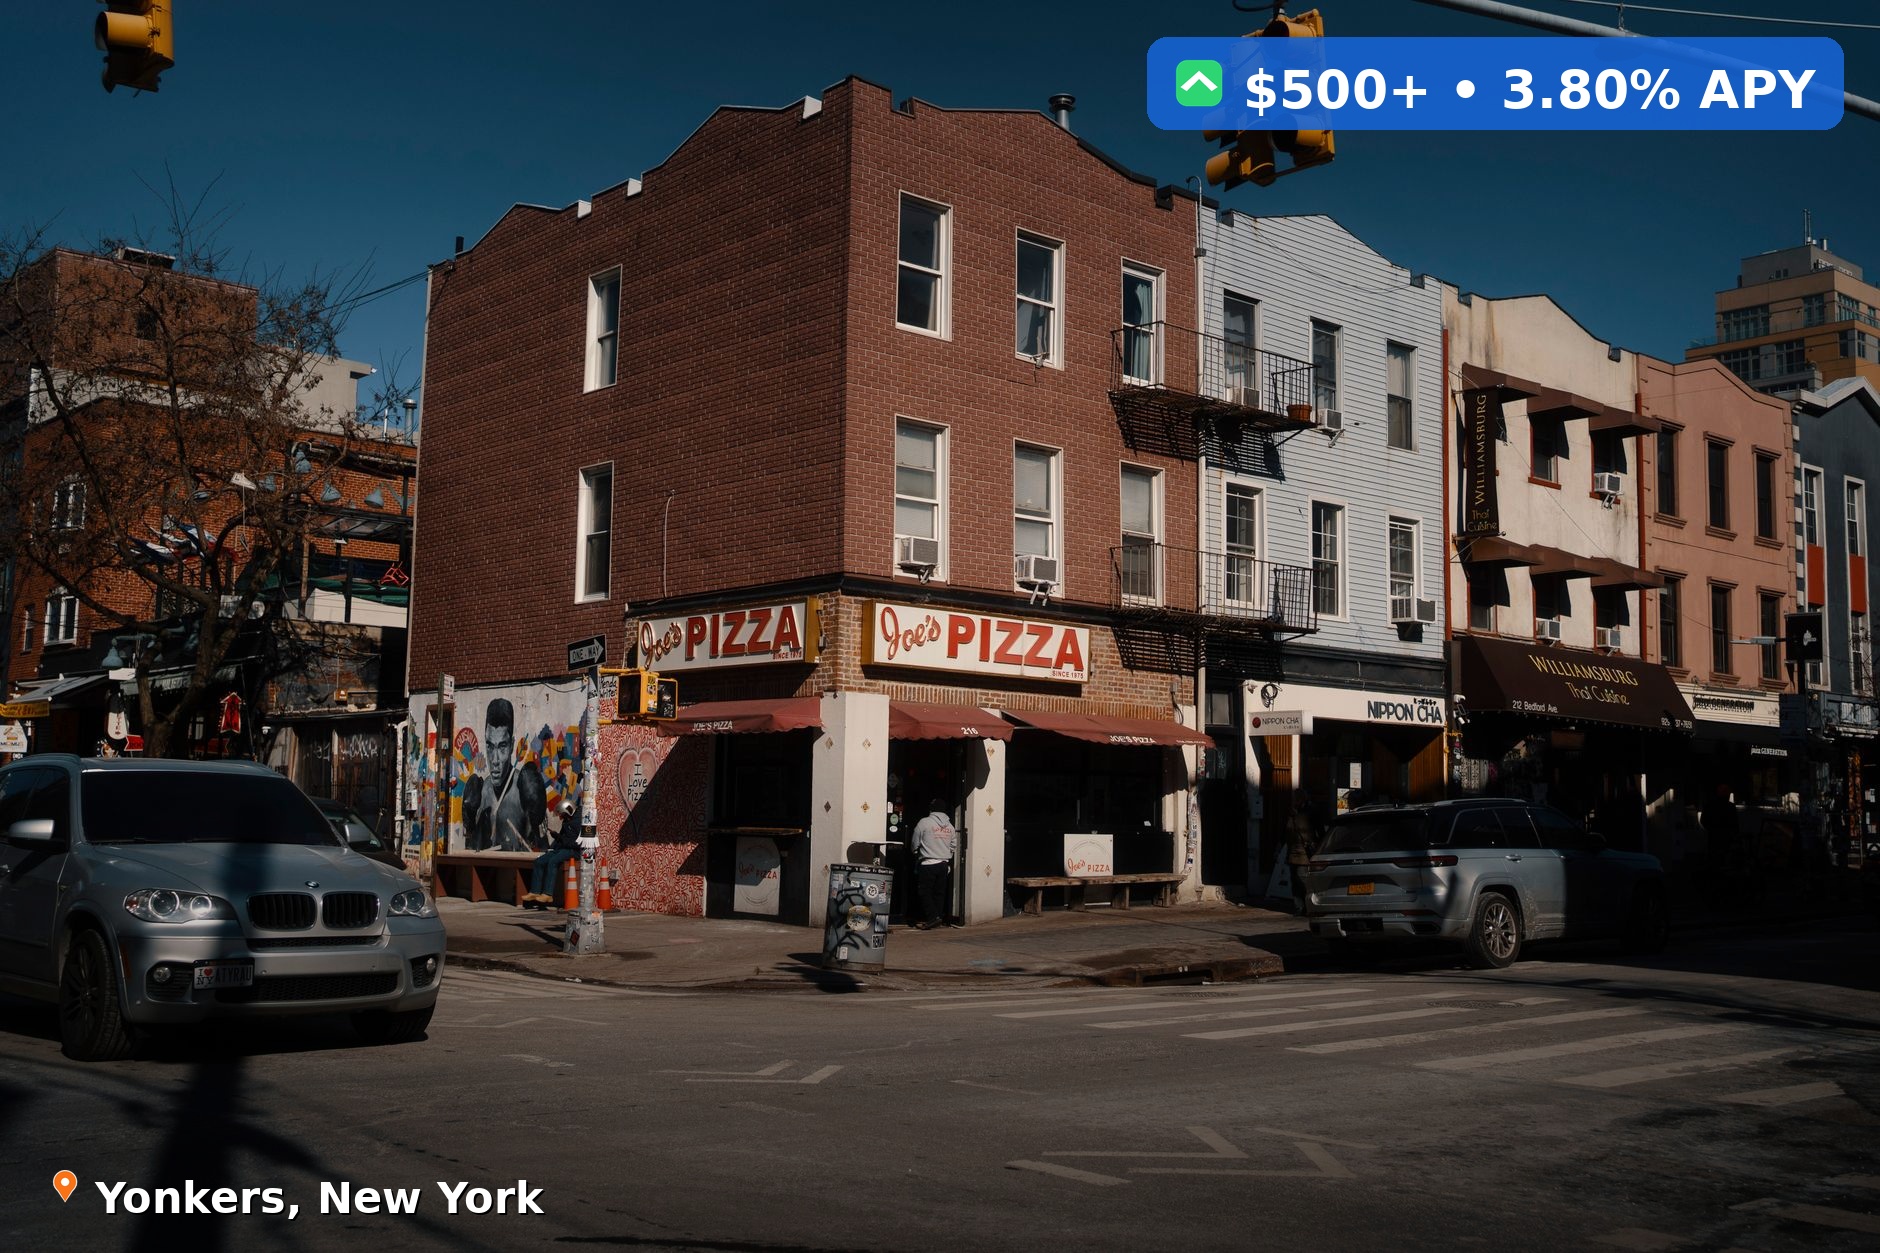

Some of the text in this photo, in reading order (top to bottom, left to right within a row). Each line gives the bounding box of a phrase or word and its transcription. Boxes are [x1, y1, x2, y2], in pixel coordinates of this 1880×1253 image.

[1475, 394, 1487, 506] WILLIAMSBURG
[1472, 509, 1490, 520] Thai
[1467, 520, 1498, 532] Cuisine
[641, 606, 802, 671] Joe's PIZZA
[880, 606, 1085, 672] Joe's PIZZA
[572, 645, 600, 661] ONE WAY
[1052, 670, 1069, 678] SINCE
[1528, 654, 1638, 686] WILLIAMSBURG
[1565, 681, 1630, 705] Thai Cuisine
[1368, 700, 1443, 724] NIPPON CHA
[1512, 700, 1522, 710] 212
[1524, 701, 1546, 712] Bedford
[713, 720, 733, 730] PIZZA
[1262, 716, 1300, 725] NIPPON CHA
[1109, 735, 1157, 744] JOE'S PIZZA
[634, 763, 642, 776] I
[628, 774, 648, 788] Love
[627, 788, 649, 802] Pizza
[1087, 864, 1111, 873] PIZZA
[197, 976, 214, 986] NY
